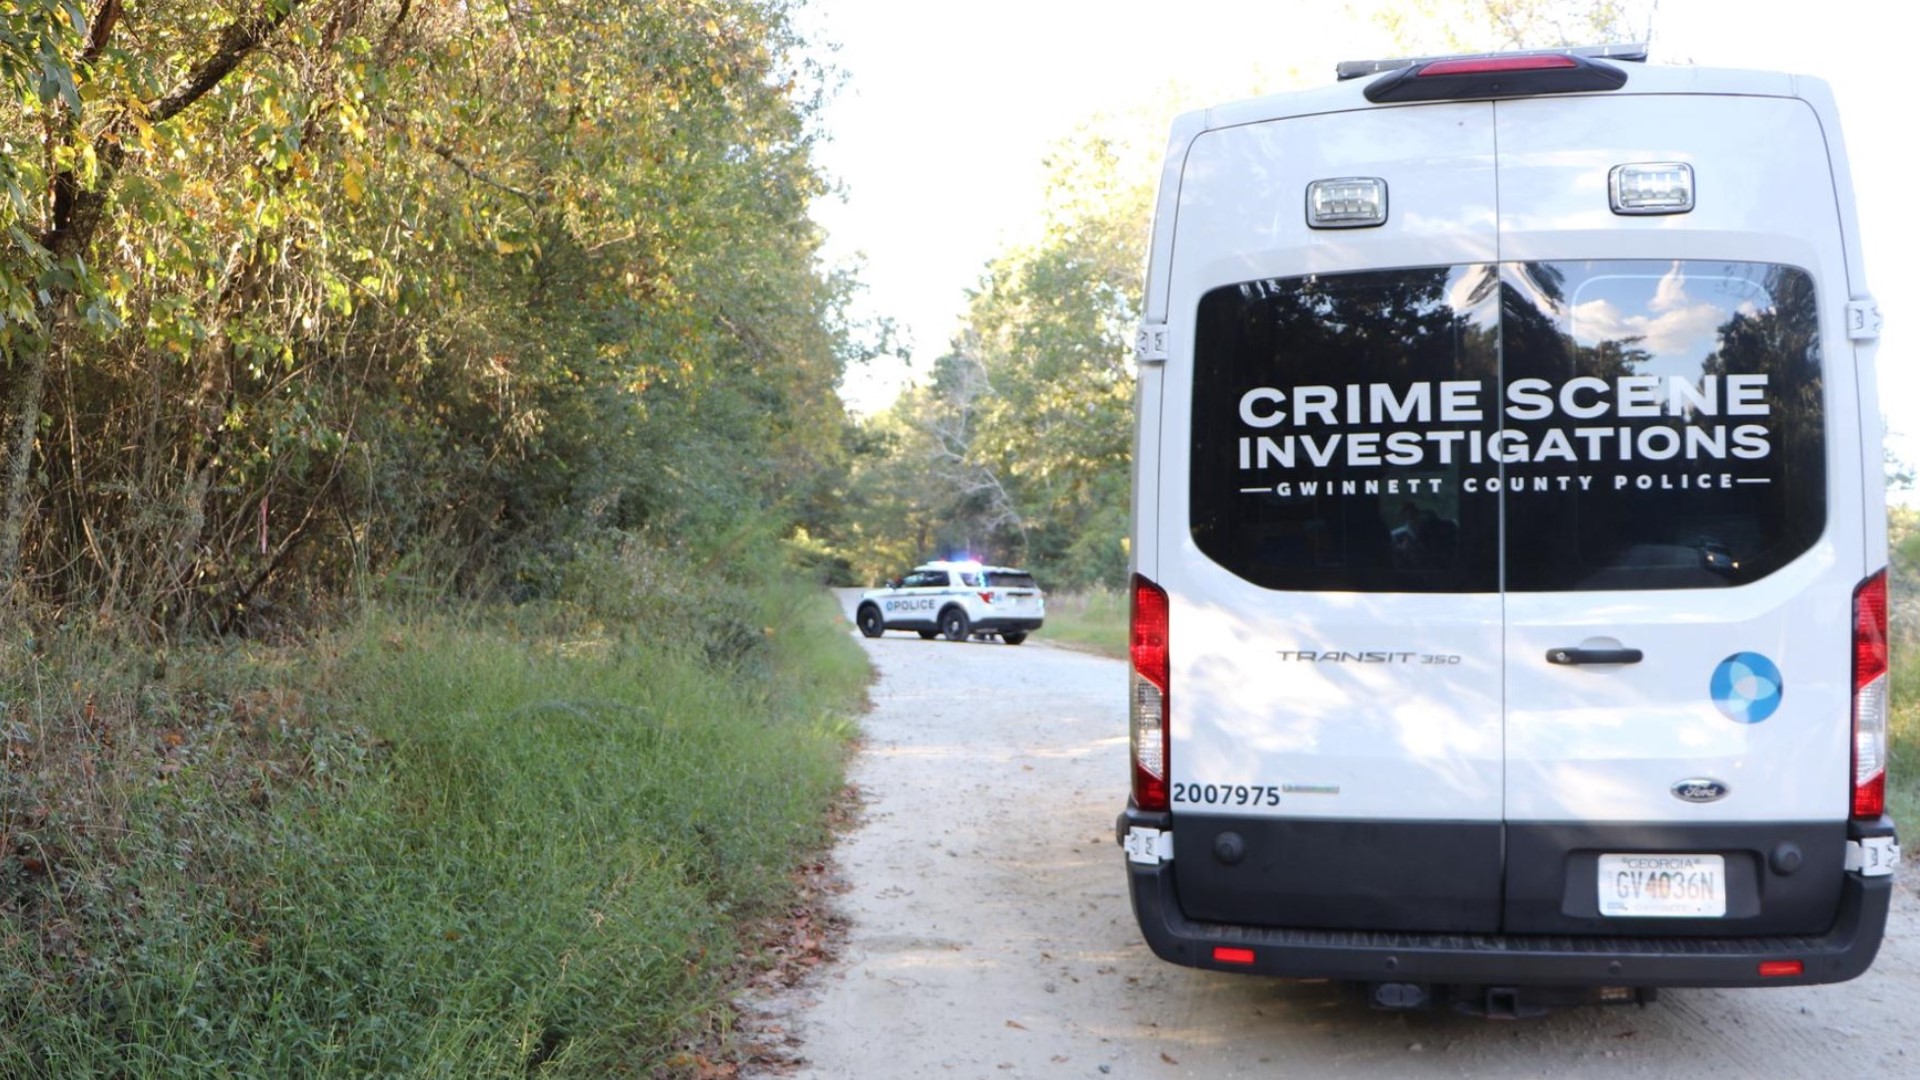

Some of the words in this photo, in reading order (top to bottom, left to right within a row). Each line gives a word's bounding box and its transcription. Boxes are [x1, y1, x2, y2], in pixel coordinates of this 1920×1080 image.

[1239, 380, 1483, 428] CRIME
[1505, 374, 1770, 420] SCENE
[1239, 424, 1771, 469] INVESTIGATIONS
[1277, 478, 1442, 496] GWINNETT
[1463, 475, 1592, 492] COUNTY
[1615, 473, 1732, 490] POLICE
[894, 599, 936, 611] POLICE
[1277, 651, 1416, 663] TRANSIT
[1421, 655, 1461, 665] 350
[1173, 783, 1281, 806] 2007975
[1684, 783, 1717, 797] Ford
[1616, 871, 1714, 899] GV4036N
